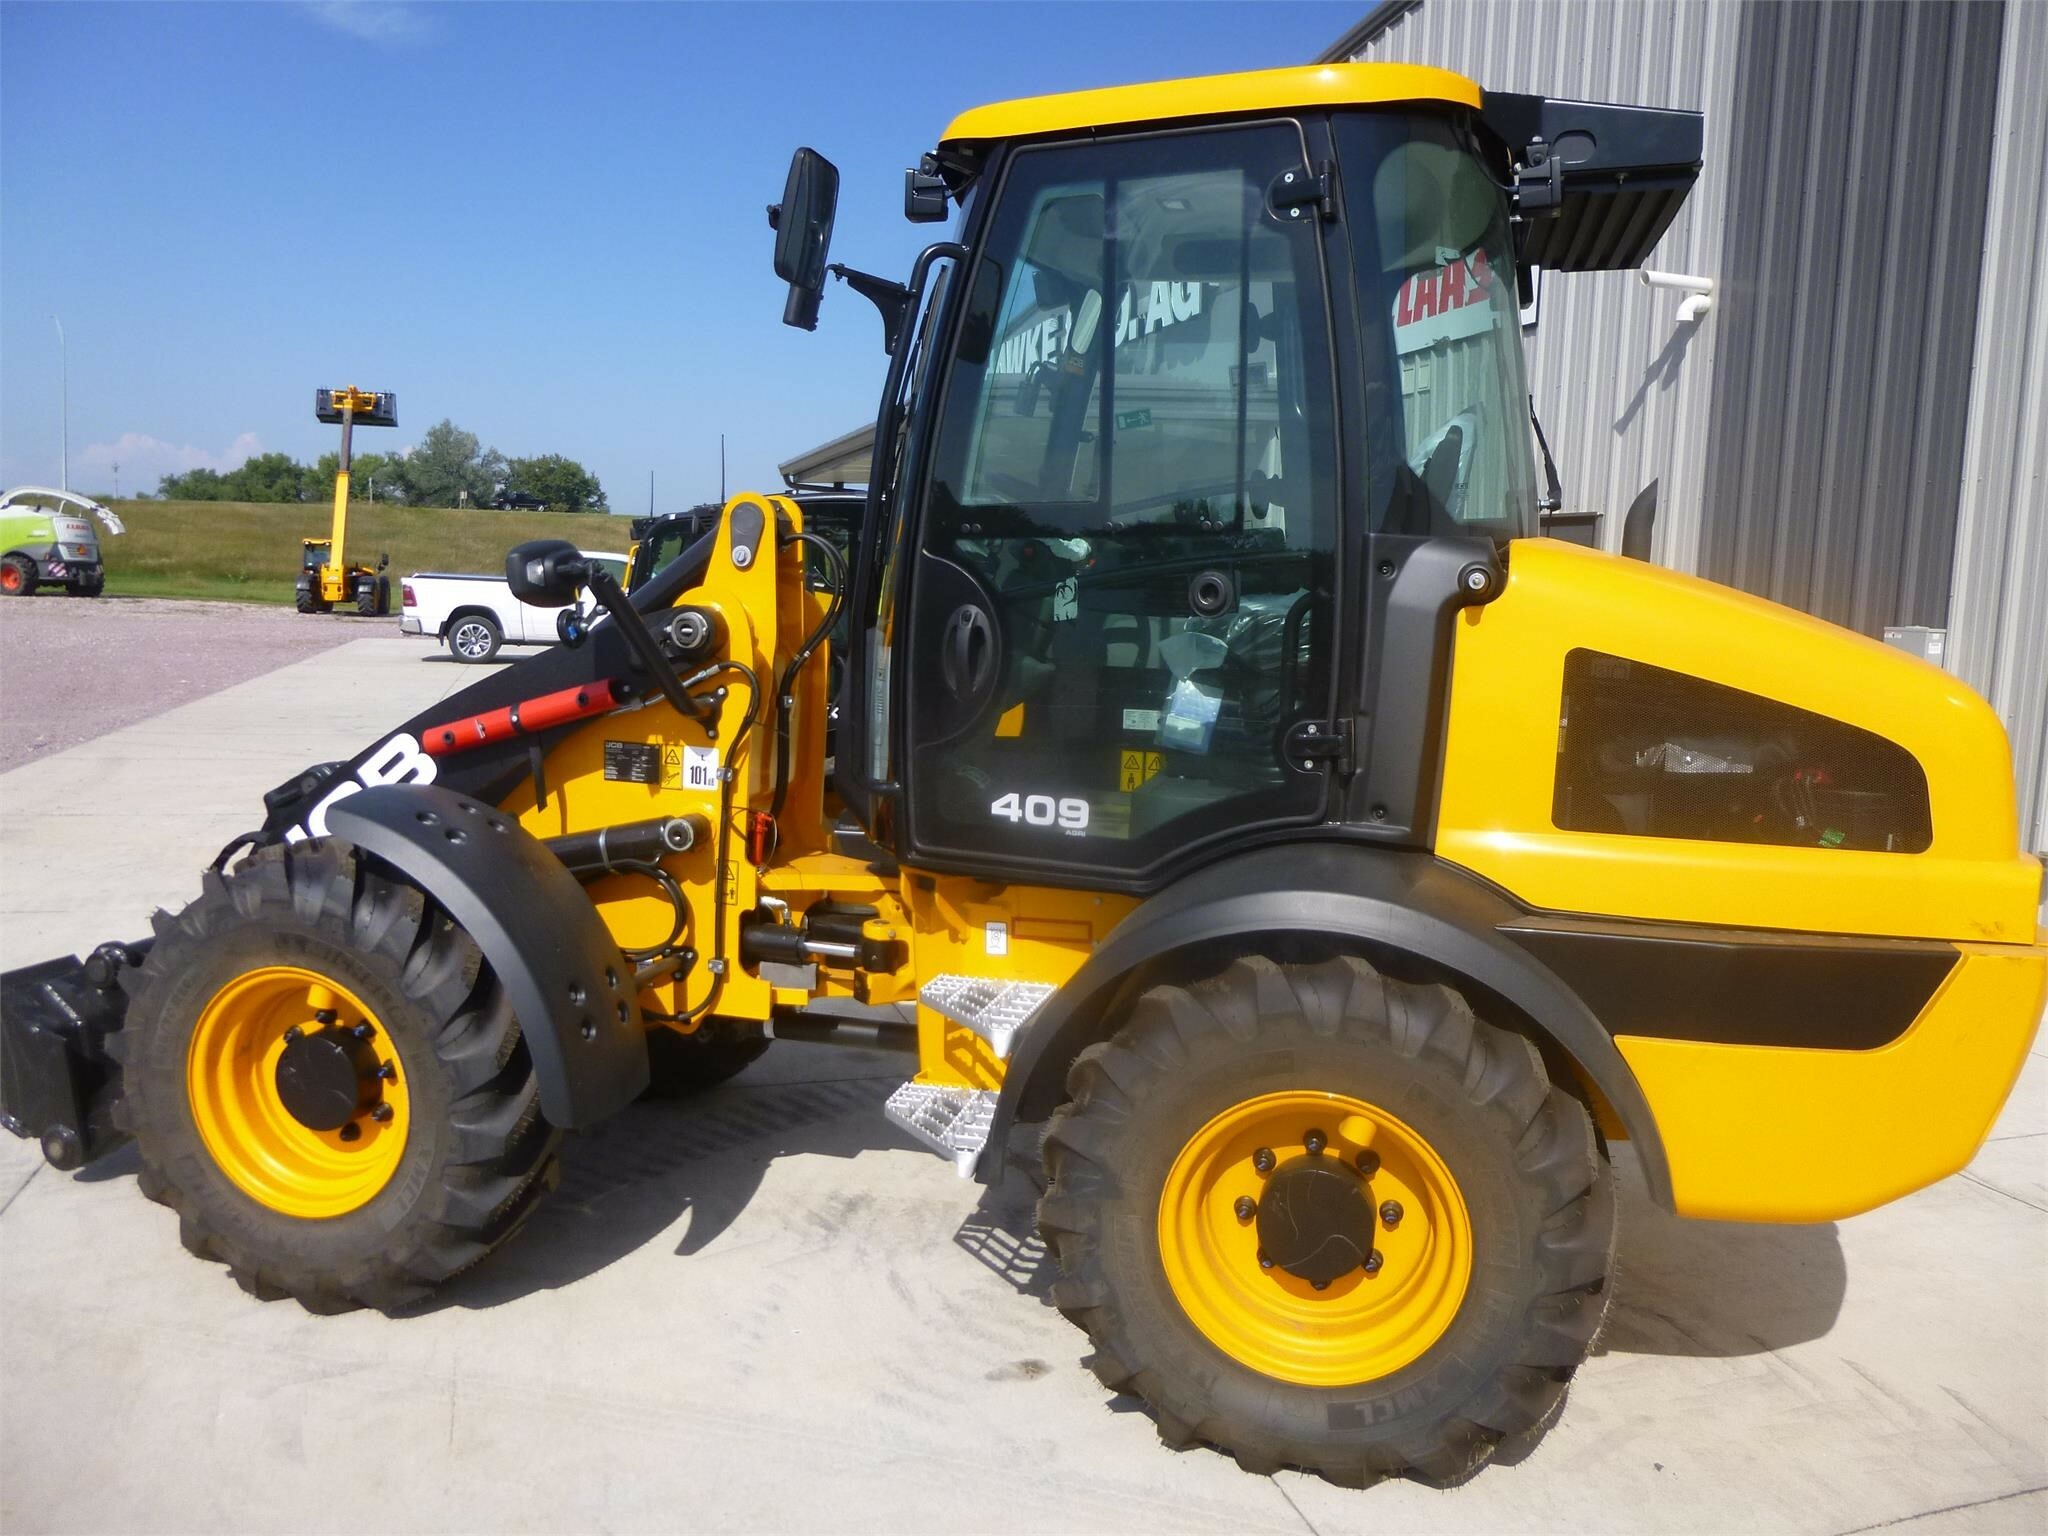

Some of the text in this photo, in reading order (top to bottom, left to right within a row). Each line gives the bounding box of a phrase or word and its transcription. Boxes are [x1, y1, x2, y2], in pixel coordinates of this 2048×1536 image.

[1397, 248, 1489, 327] LAAS
[690, 765, 708, 786] 101
[991, 792, 1090, 829] 409
